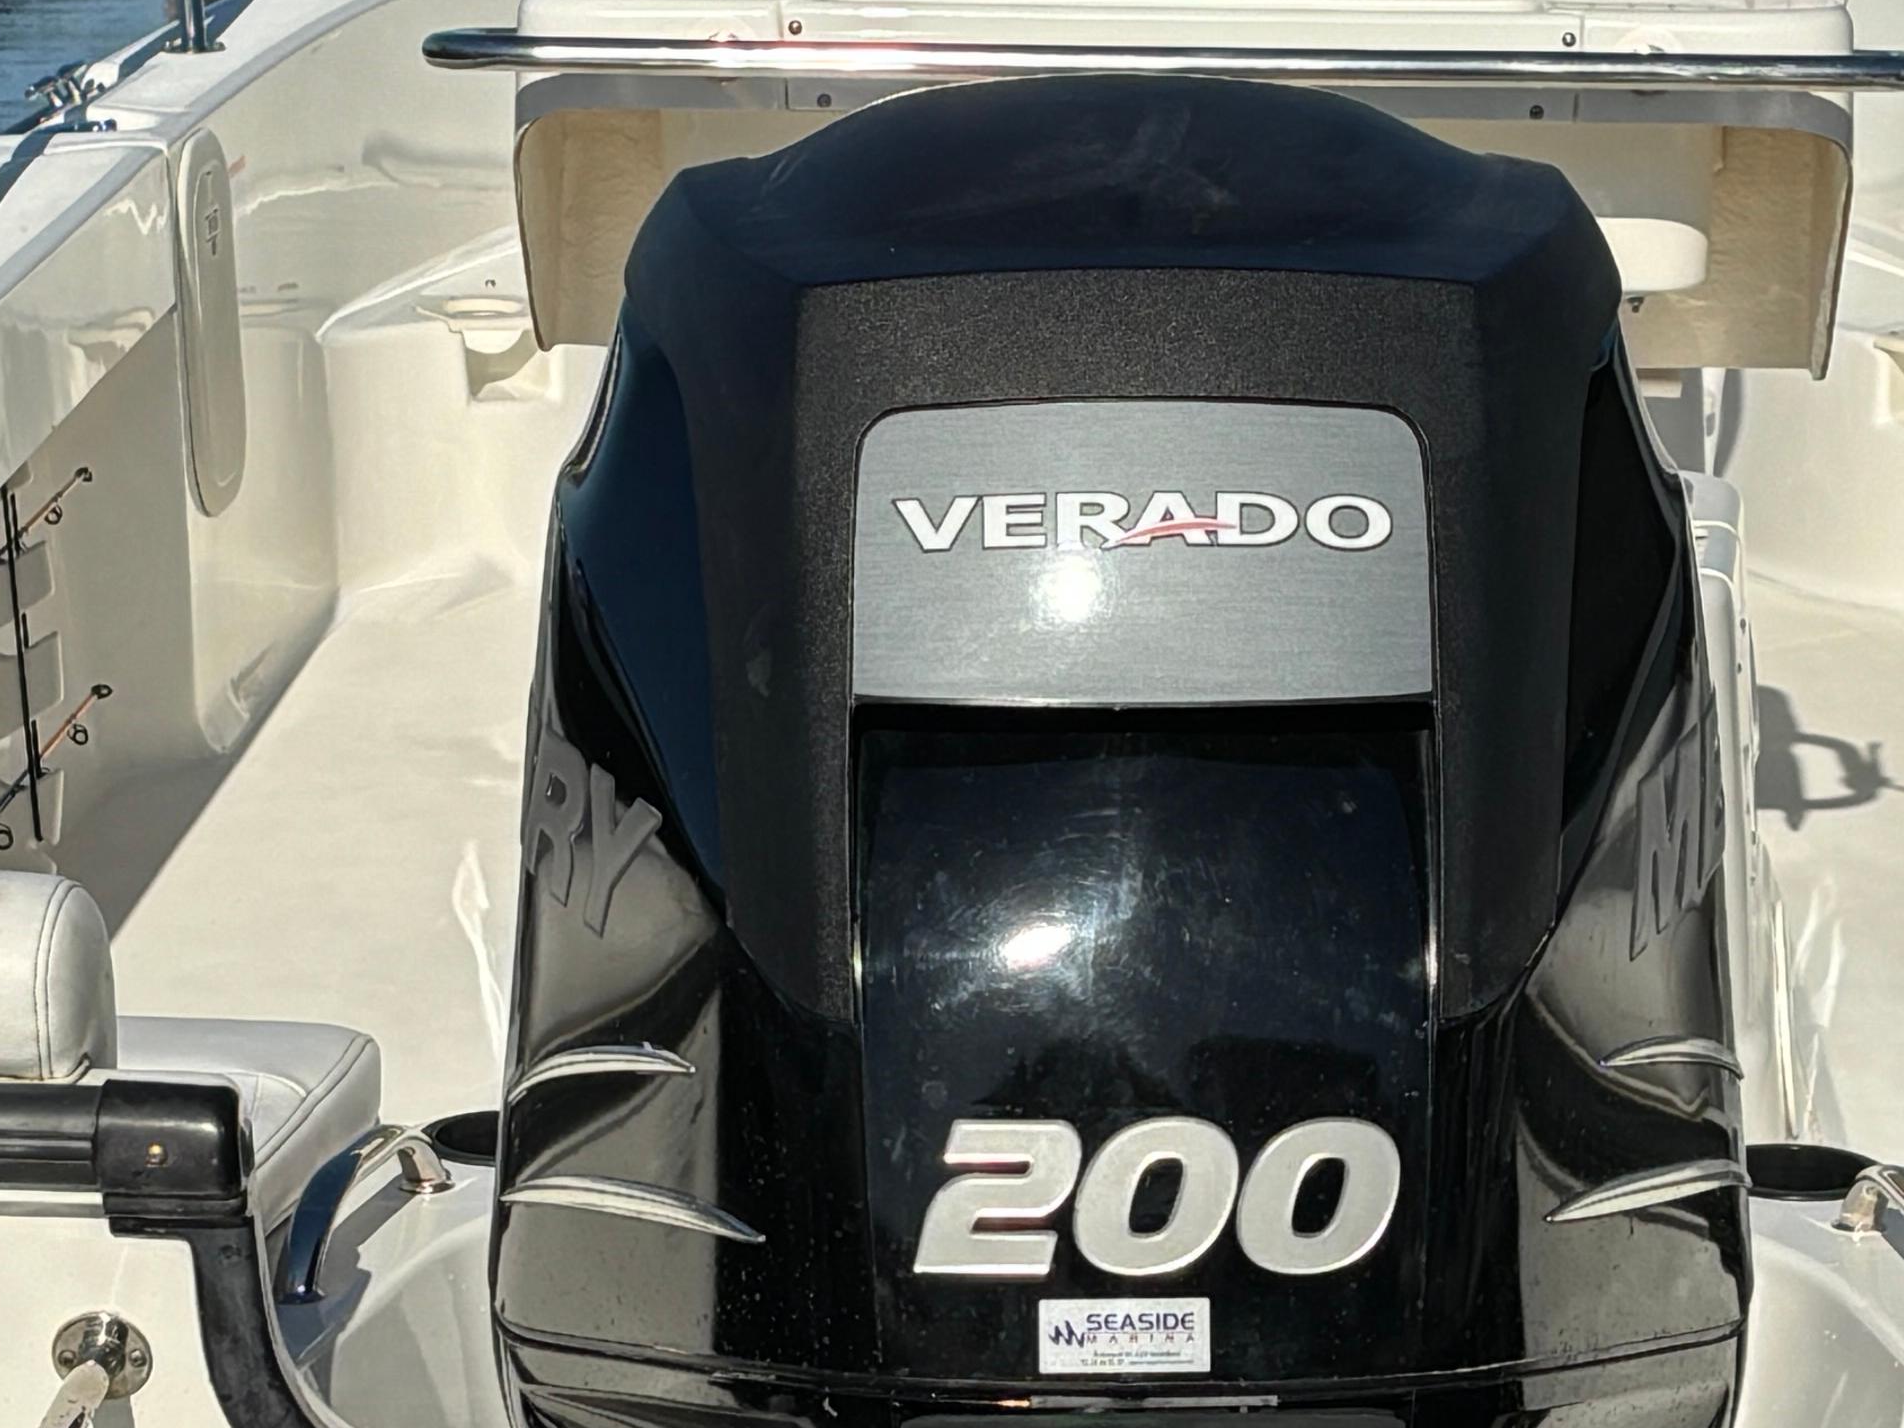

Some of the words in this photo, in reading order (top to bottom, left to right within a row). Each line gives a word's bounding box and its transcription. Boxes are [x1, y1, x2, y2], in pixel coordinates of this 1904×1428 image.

[892, 489, 1394, 553] VERADO
[913, 1116, 1401, 1277] 200
[1086, 1312, 1195, 1331] SEASIDE
[1086, 1334, 1195, 1345] MARINA
